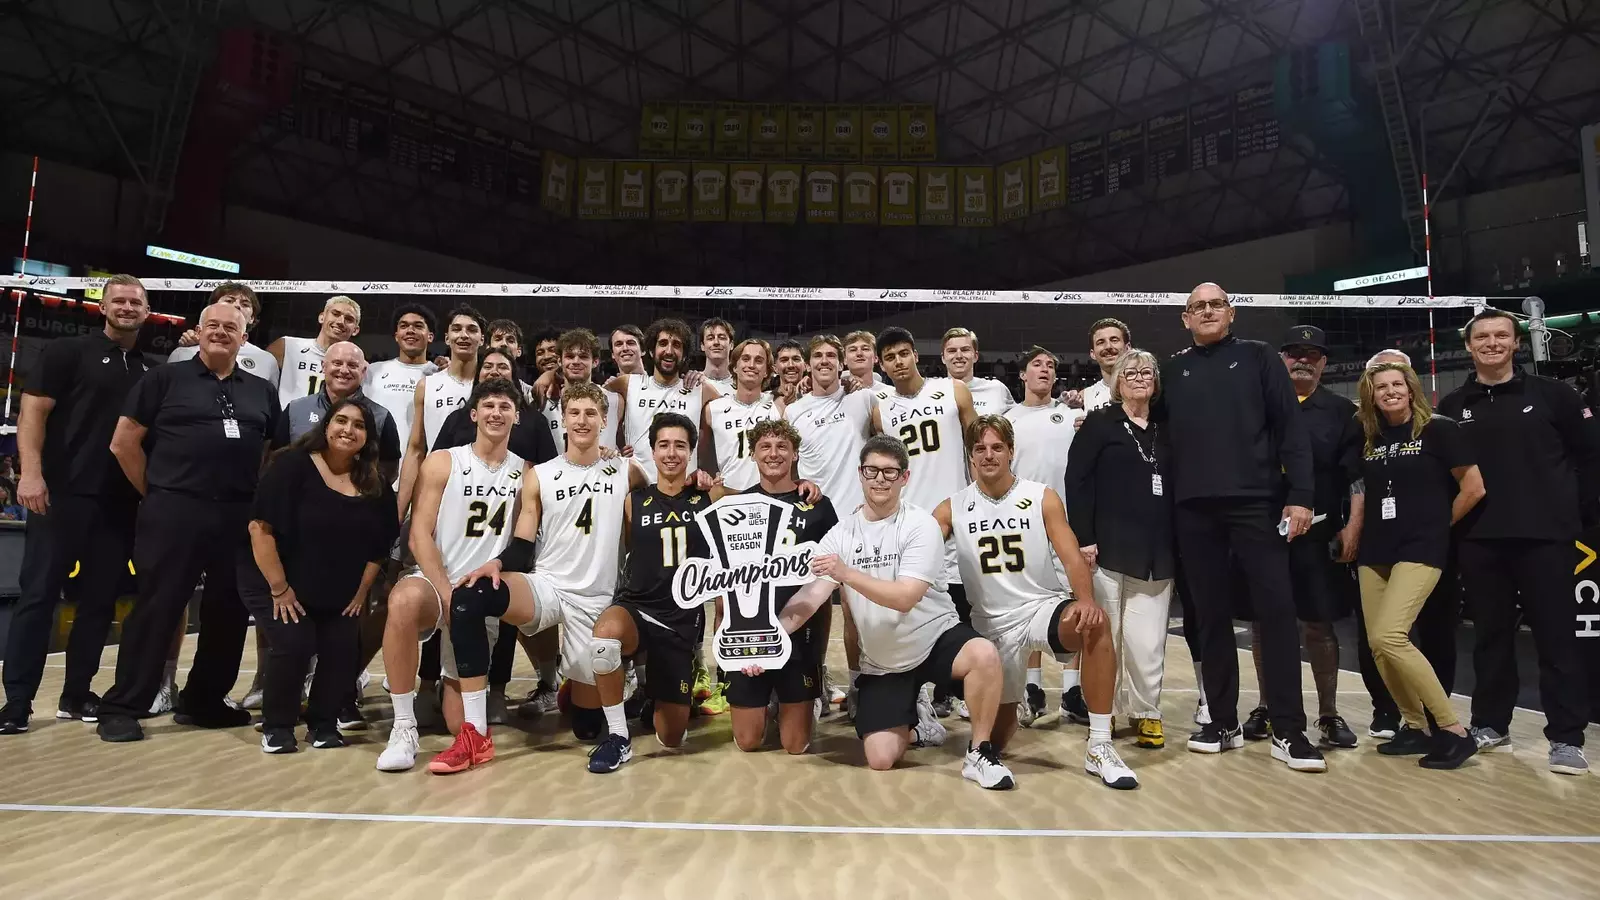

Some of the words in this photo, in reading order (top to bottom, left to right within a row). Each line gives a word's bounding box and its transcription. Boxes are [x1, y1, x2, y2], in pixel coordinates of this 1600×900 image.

[1355, 277, 1370, 286] GO
[1372, 272, 1406, 283] BEACH
[540, 285, 560, 293] asics
[714, 287, 733, 295] asics
[888, 290, 907, 298] asics
[1062, 292, 1082, 300] asics
[1405, 296, 1425, 304] asics
[25, 316, 93, 336] BURGE
[638, 398, 687, 410] BEACH
[891, 405, 944, 428] BEACH
[899, 418, 941, 457] 20
[463, 485, 517, 498] BEACH
[556, 481, 613, 501] BEACH
[465, 500, 507, 538] 24
[574, 497, 594, 535] 4
[748, 518, 767, 526] WEST
[969, 517, 1030, 534] BEACH
[727, 531, 763, 543] REGULAR
[659, 525, 688, 567] 11
[730, 541, 761, 551] SEASON
[977, 533, 1026, 575] 25
[680, 548, 815, 602] Champions
